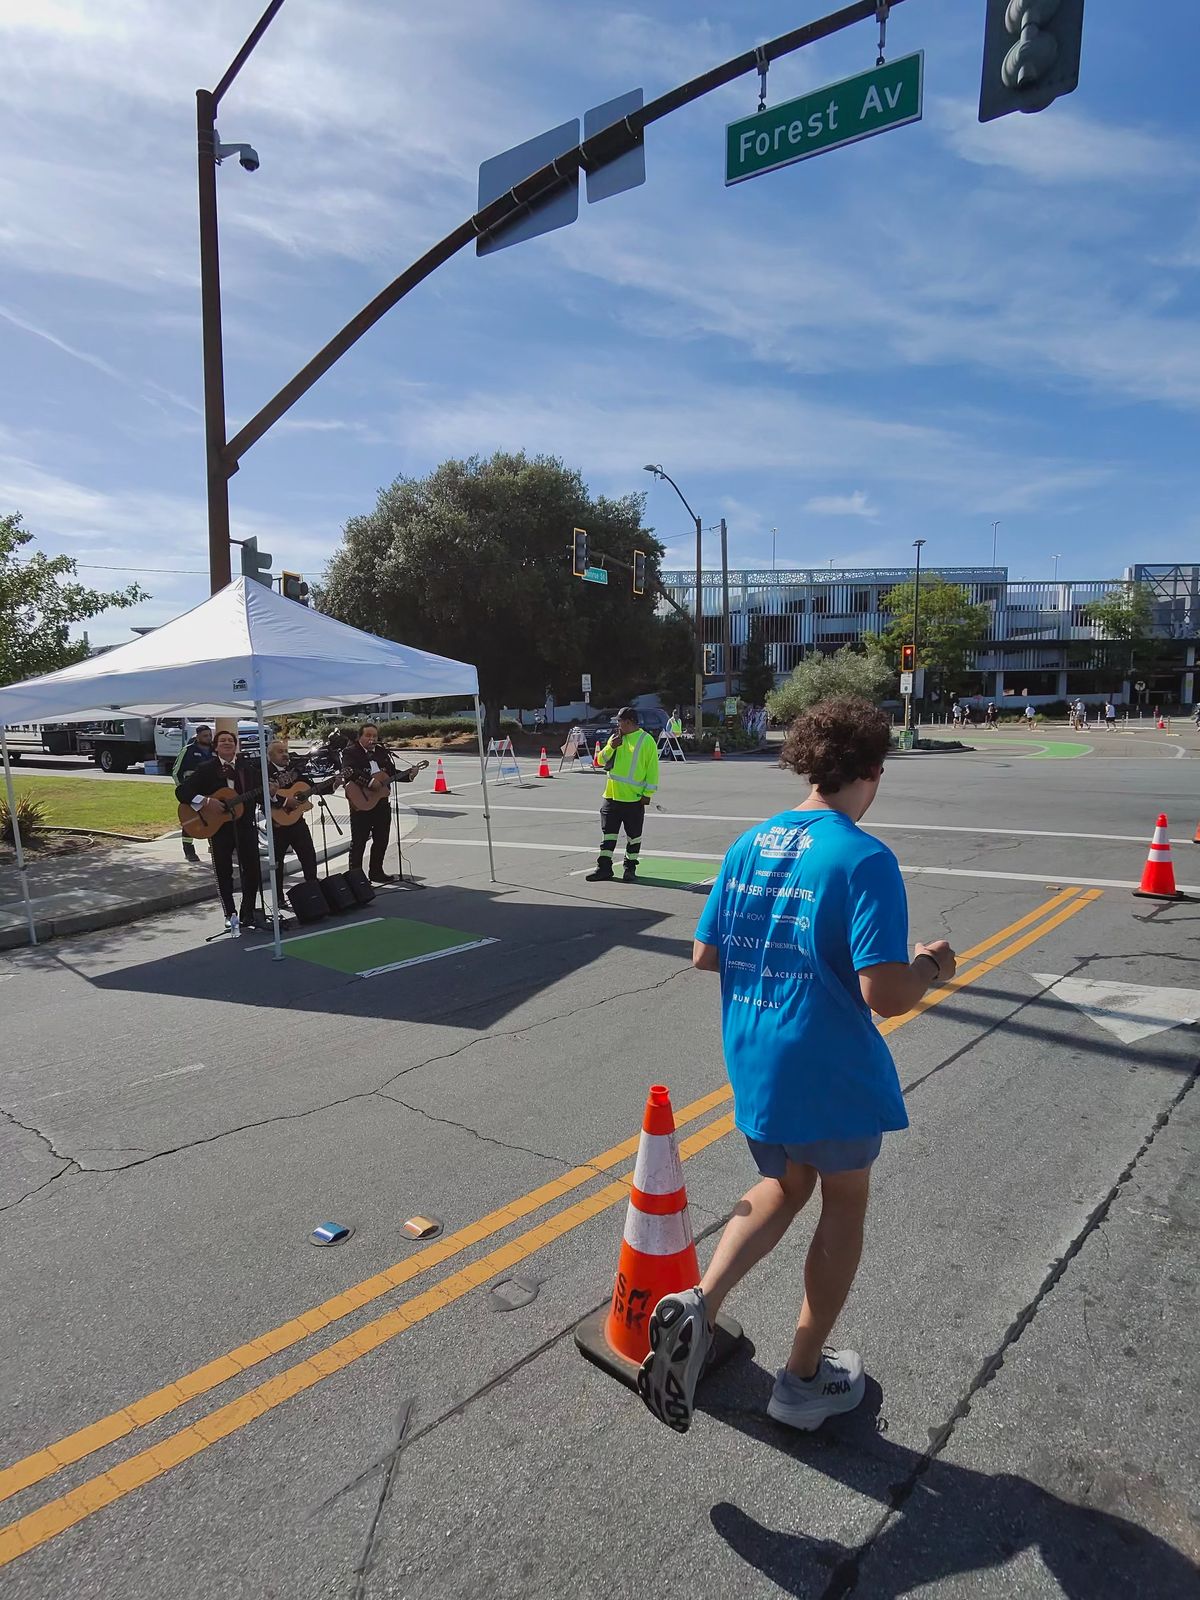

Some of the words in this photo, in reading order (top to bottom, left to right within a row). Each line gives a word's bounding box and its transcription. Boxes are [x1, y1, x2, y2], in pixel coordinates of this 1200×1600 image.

[739, 100, 839, 163] Forest
[859, 81, 903, 120] Av
[769, 826, 788, 836] SAN
[737, 883, 763, 897] KAISER
[746, 912, 766, 921] ROW
[774, 972, 814, 980] ACRISURE
[732, 993, 749, 1004] RUN
[753, 999, 779, 1009] LOCAL
[822, 1379, 851, 1396] HOKA
